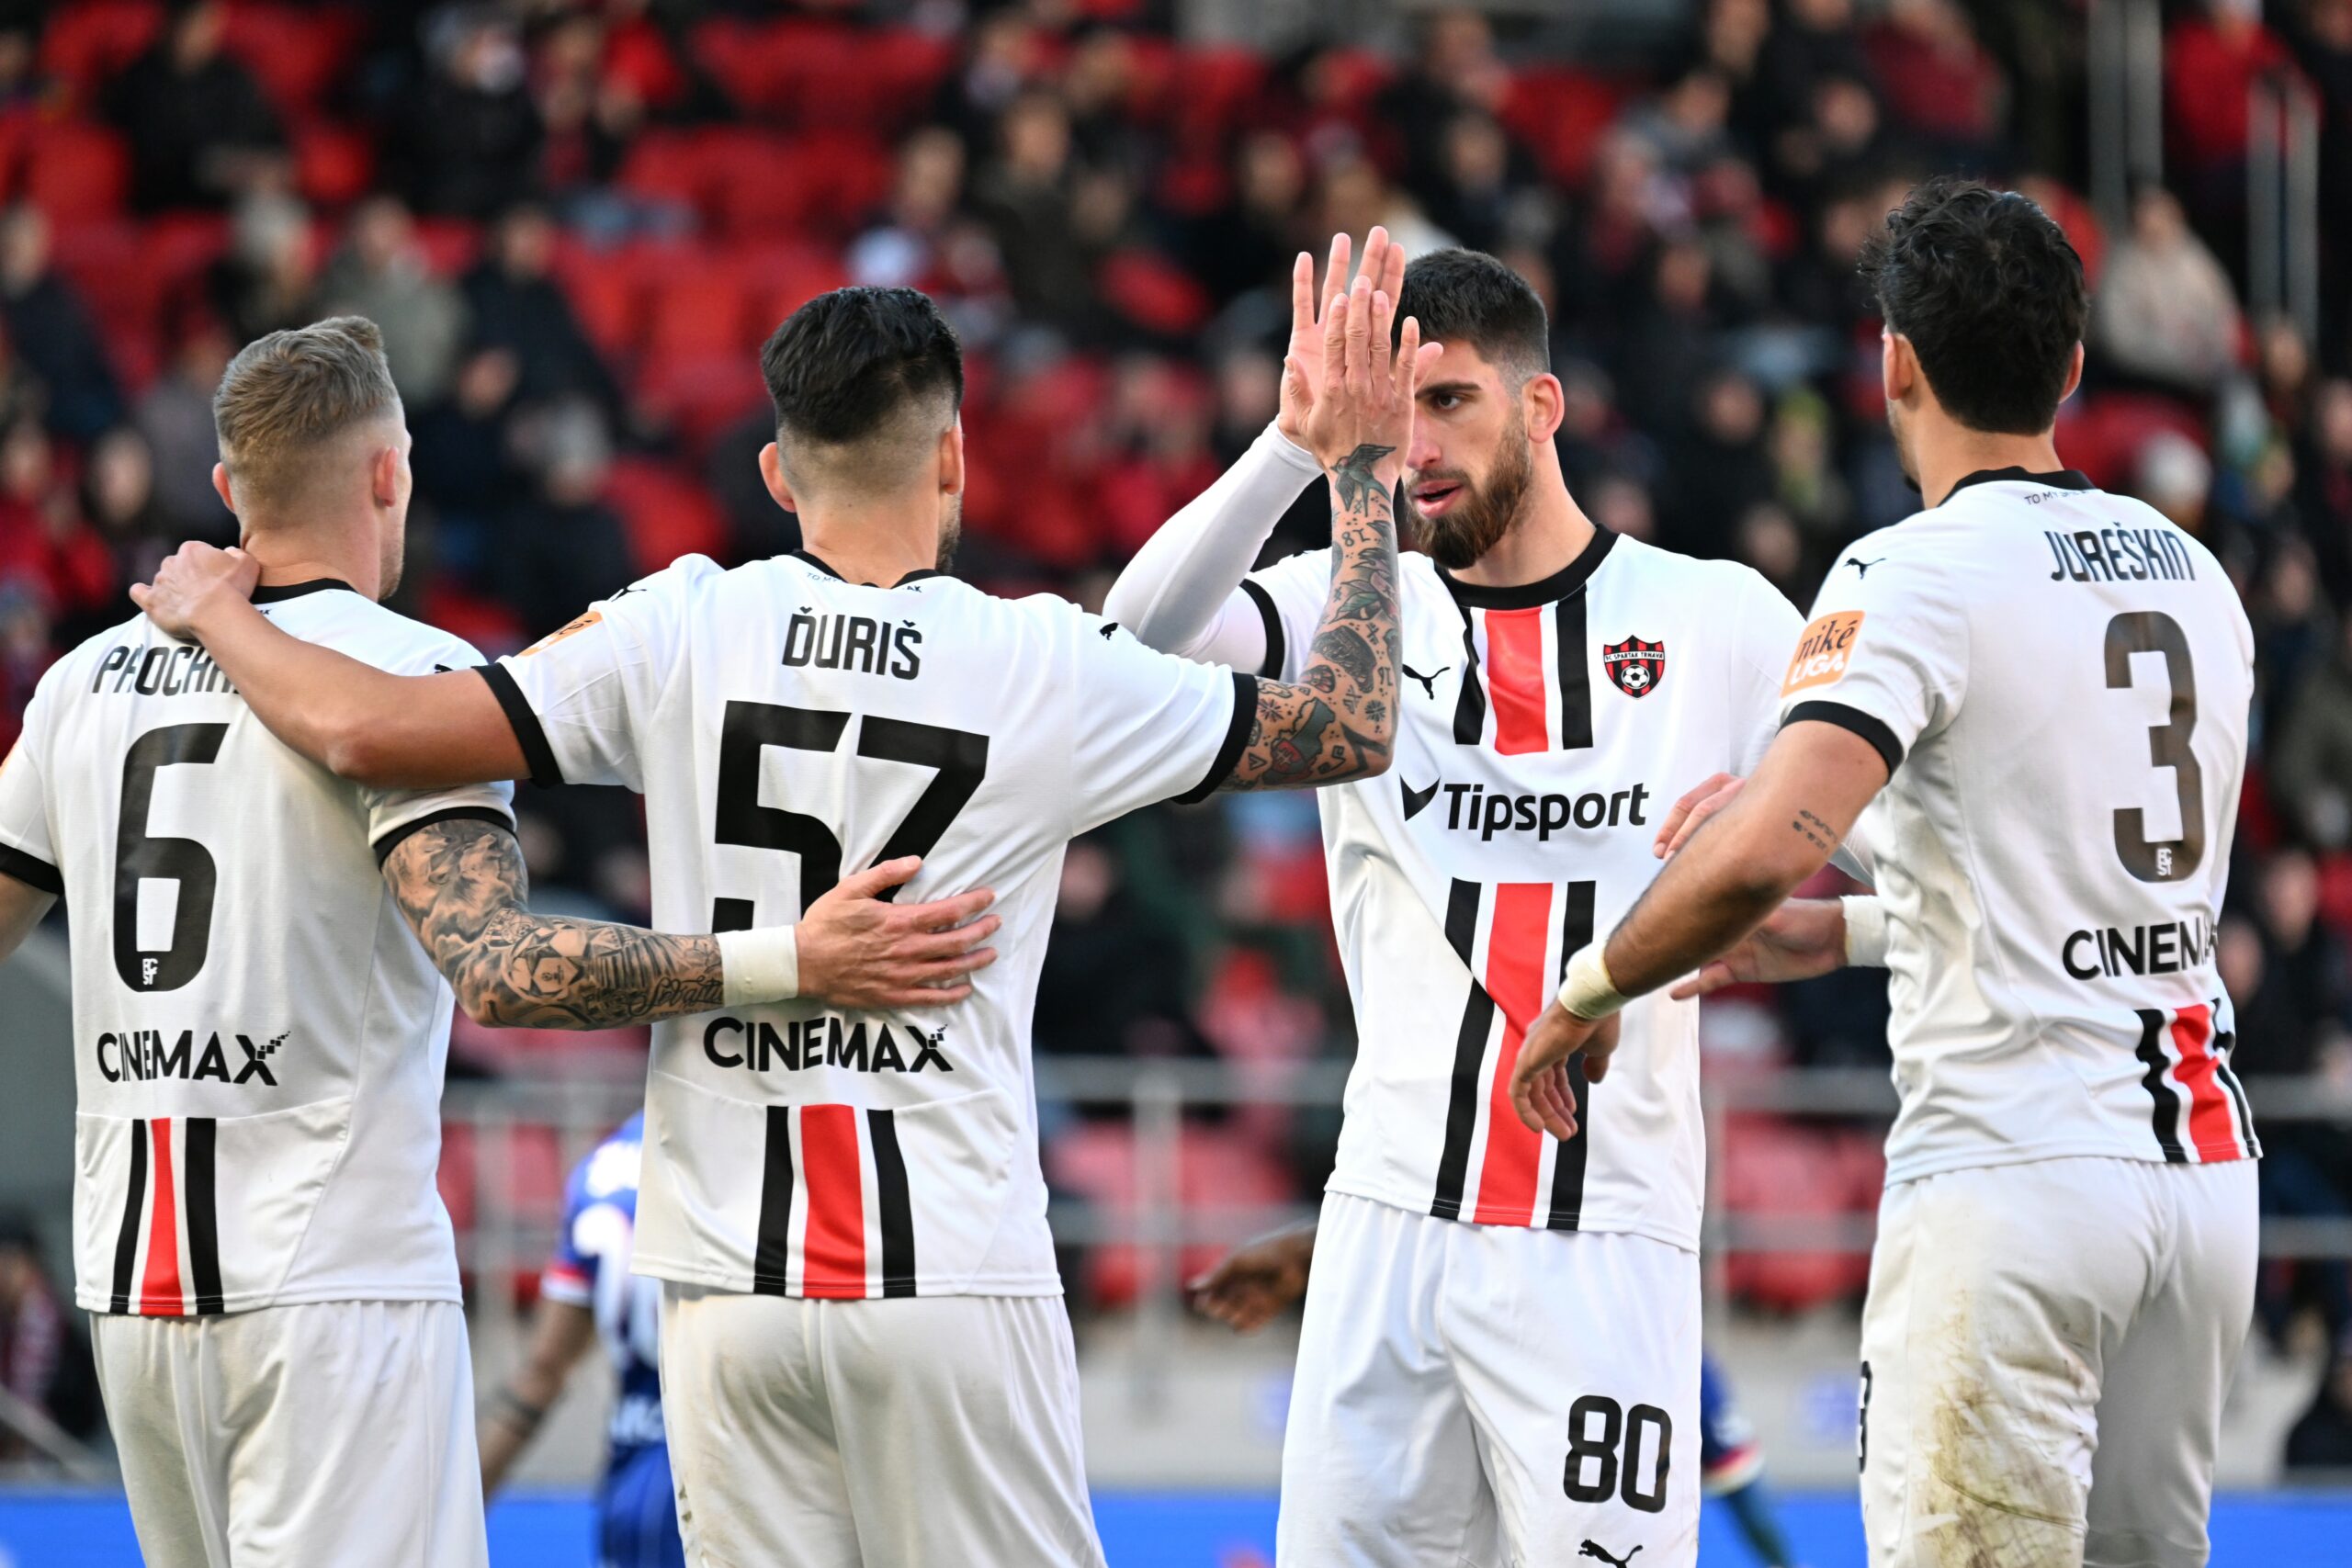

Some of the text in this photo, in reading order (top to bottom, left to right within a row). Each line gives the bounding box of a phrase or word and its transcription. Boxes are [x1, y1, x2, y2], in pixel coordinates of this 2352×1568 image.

[2043, 521, 2197, 582] JUREŠKIN
[782, 606, 922, 681] ĎURIŠ
[2104, 610, 2207, 883] 3
[712, 699, 990, 931] 57
[1443, 782, 1650, 841] Tipsport
[113, 722, 231, 992] 6
[2062, 917, 2219, 981] CINEM
[96, 1030, 291, 1087] CINEMAX
[702, 1016, 954, 1073] CINEMAX
[1562, 1393, 1673, 1514] 80
